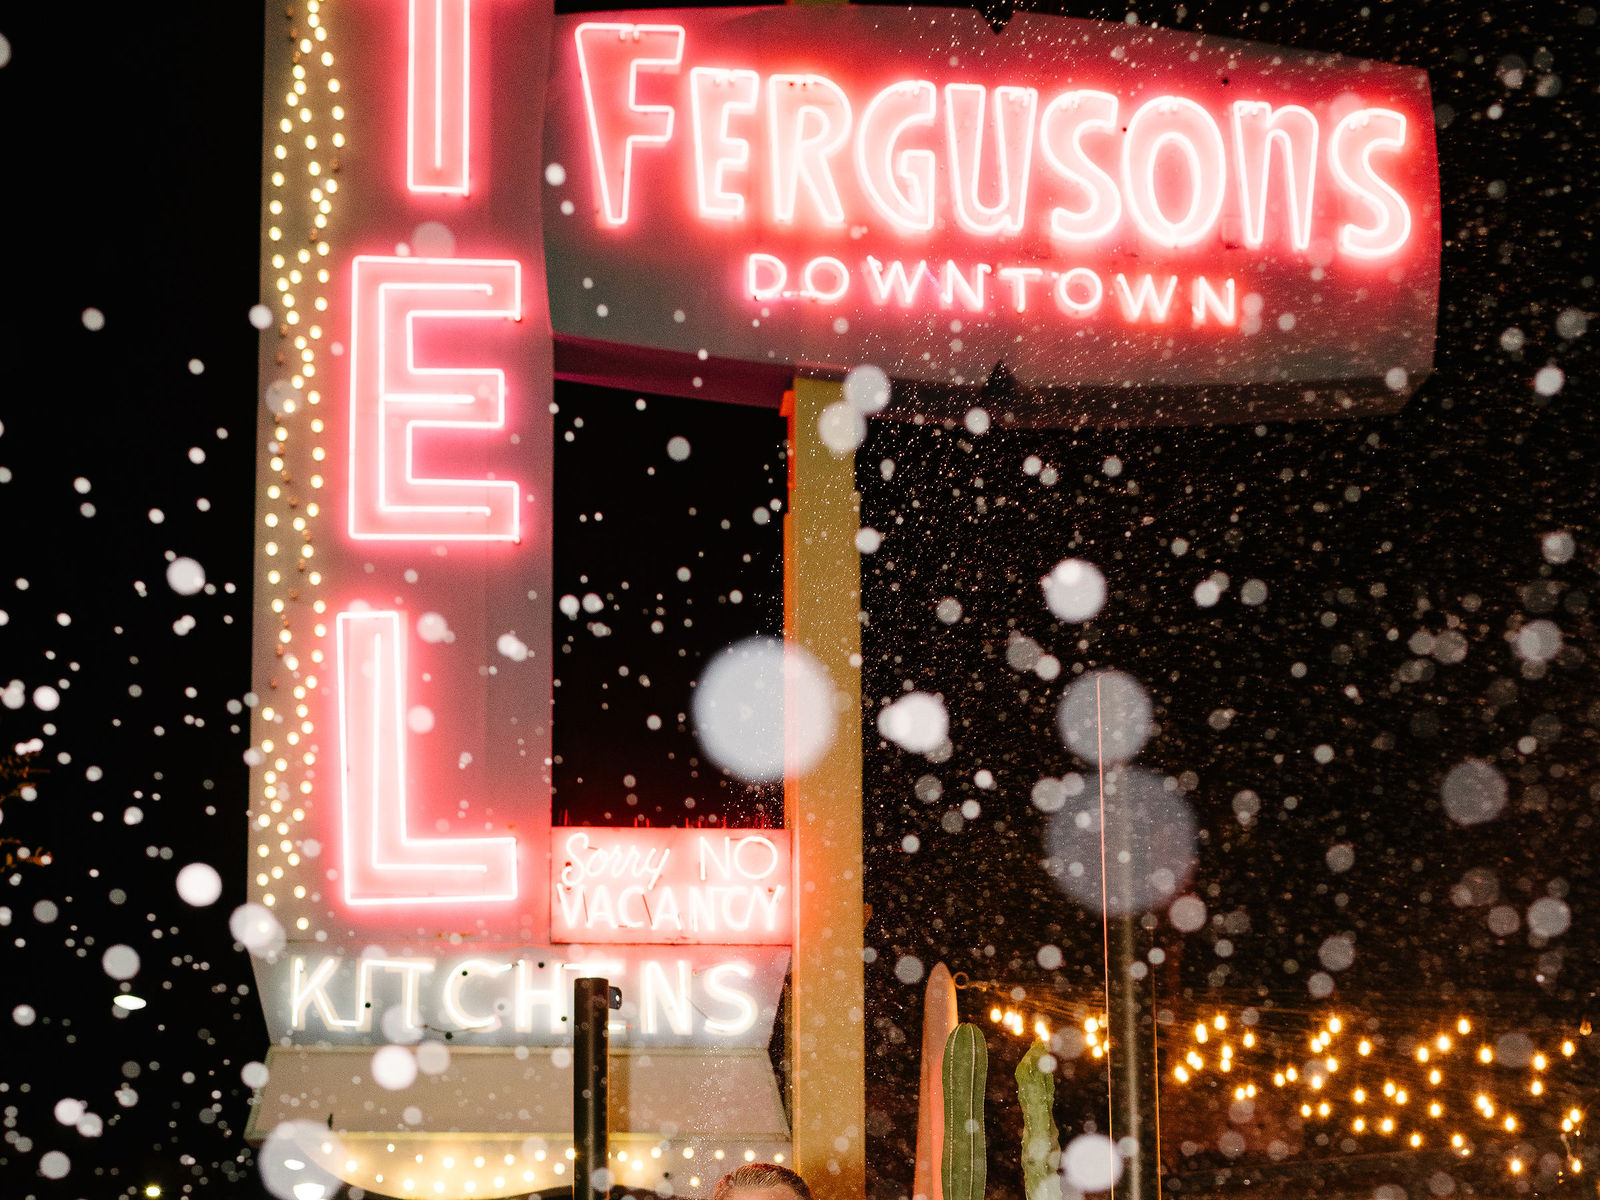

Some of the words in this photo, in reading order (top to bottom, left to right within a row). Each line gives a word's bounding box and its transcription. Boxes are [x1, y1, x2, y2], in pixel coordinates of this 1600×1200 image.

[746, 252, 1238, 328] DOWNTOWN
[561, 832, 670, 890] Sorry
[699, 835, 779, 881] NO
[556, 881, 786, 933] VACANCY
